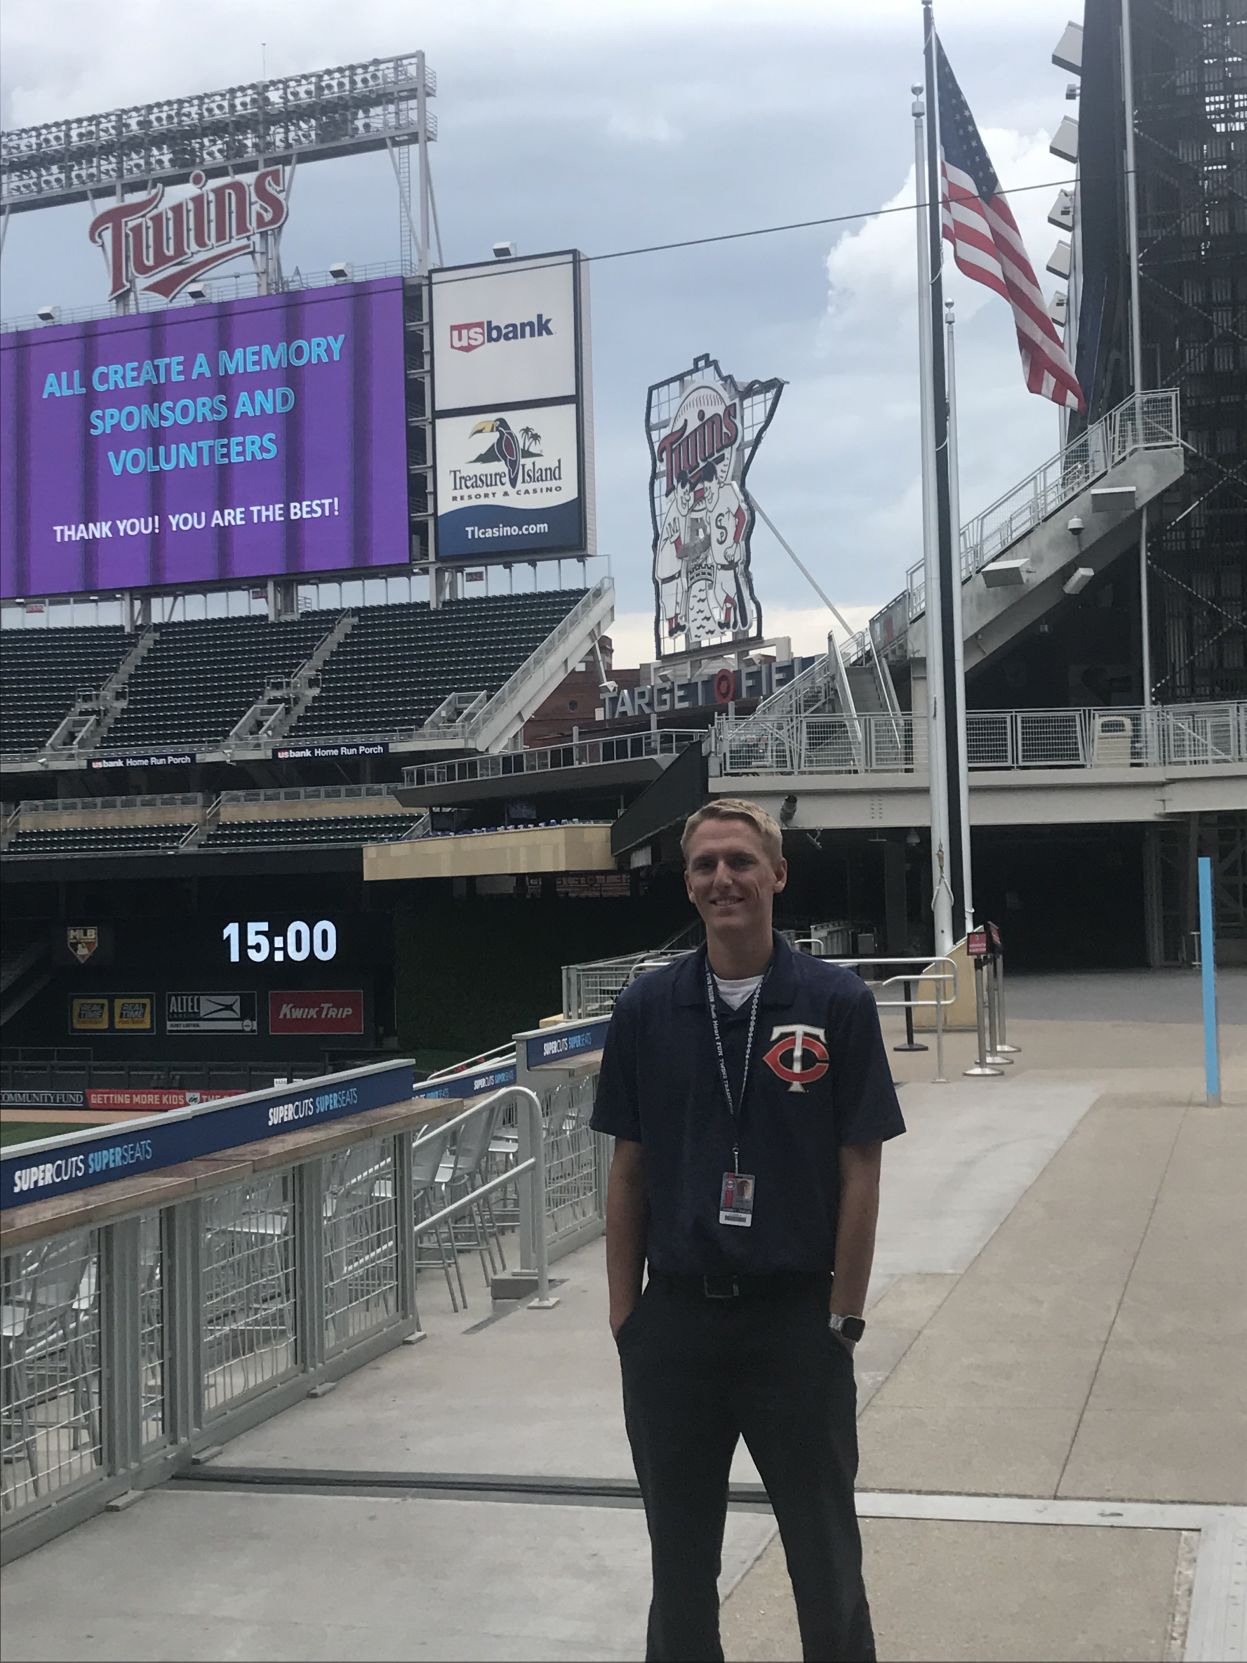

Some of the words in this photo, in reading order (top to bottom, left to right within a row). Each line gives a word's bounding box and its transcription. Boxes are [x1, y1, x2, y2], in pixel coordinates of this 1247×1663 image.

[88, 164, 288, 303] Twins
[42, 370, 86, 399] ALL
[92, 355, 184, 392] CREATE
[192, 352, 211, 380] A
[218, 334, 345, 376] MEMORY
[90, 393, 227, 436] SPONSORS
[235, 387, 295, 418] AND
[108, 432, 277, 476] VOLUNTEERS
[657, 402, 738, 498] Twins
[450, 467, 507, 491] Treasure
[521, 458, 562, 485] Island
[452, 491, 497, 502] RESORT
[503, 490, 510, 498] &
[516, 484, 563, 497] CASINO
[53, 520, 112, 543] THANK
[115, 516, 160, 539] YOU!
[169, 511, 206, 532] YOU
[211, 507, 245, 527] ARE
[250, 503, 285, 523] THE
[290, 497, 339, 520] BEST!
[465, 521, 549, 540] TIcasino.com
[599, 680, 708, 720] TARGET
[126, 757, 149, 767] Home
[150, 756, 166, 766] Run
[167, 754, 191, 765] Porch
[314, 747, 339, 758] Home
[340, 745, 357, 756] Run
[359, 744, 384, 755] Porch
[70, 929, 96, 939] MLB
[222, 920, 337, 963] 15:00
[169, 996, 200, 1013] ALTEC
[279, 1004, 317, 1019] KWIK
[320, 1003, 354, 1018] TRIP
[543, 1038, 568, 1056] SUPERCUTS
[474, 1075, 494, 1091] SUPERCUTS
[56, 1093, 84, 1103] FUND
[91, 1093, 131, 1105] GETTING
[132, 1093, 161, 1105] MORE
[163, 1093, 185, 1105] KIDS
[268, 1098, 314, 1126] SUPERCUTS
[315, 1088, 358, 1114] SUPERSEATS
[13, 1155, 84, 1193] SUPERCUTS
[88, 1140, 152, 1174] SUPERSEATS
